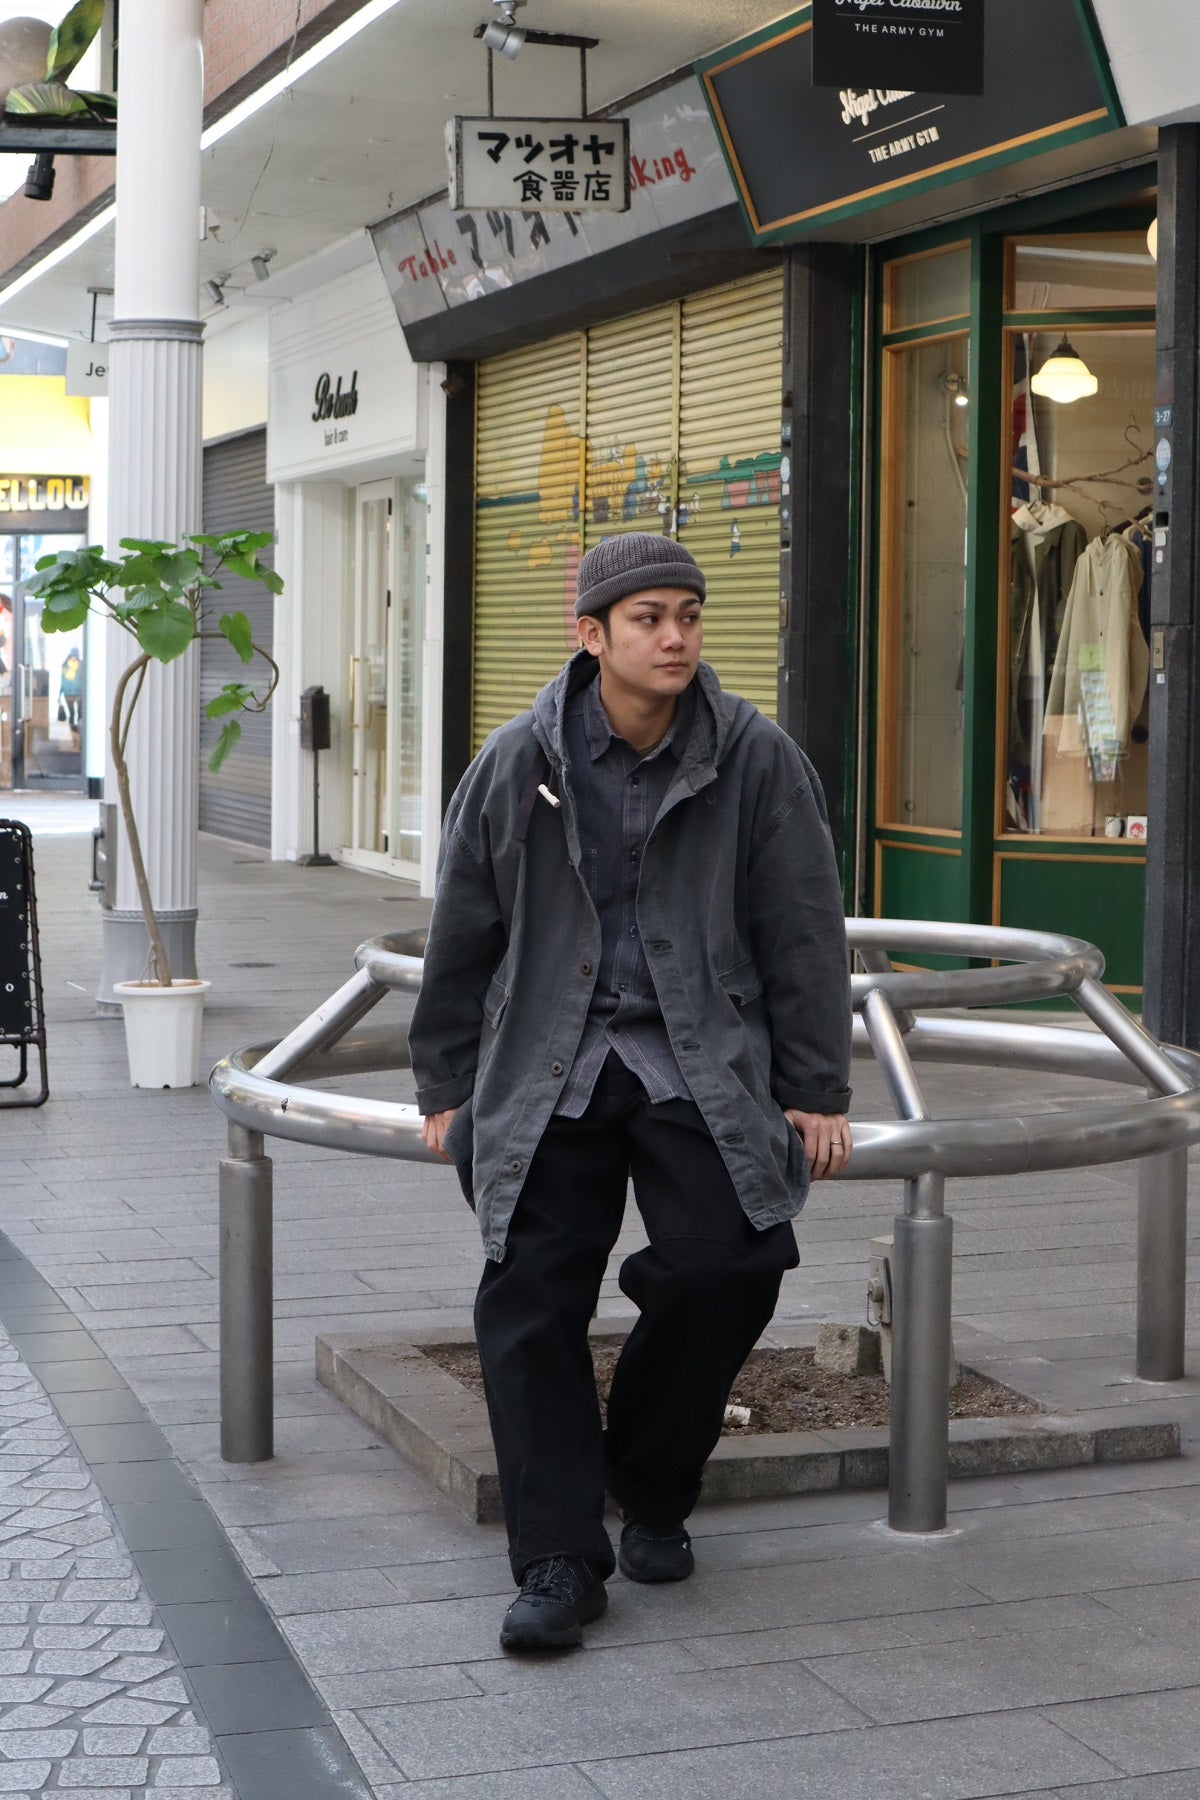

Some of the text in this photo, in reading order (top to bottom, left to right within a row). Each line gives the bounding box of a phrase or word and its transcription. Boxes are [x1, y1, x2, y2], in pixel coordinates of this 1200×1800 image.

[855, 23, 944, 37] THE ARMY GYM
[477, 131, 615, 165] マツオヤ
[868, 126, 940, 163] THE ARMY GYM
[513, 169, 612, 202] 食器店
[398, 240, 457, 282] Table
[85, 361, 109, 378] Je
[1155, 411, 1170, 423] 3-27
